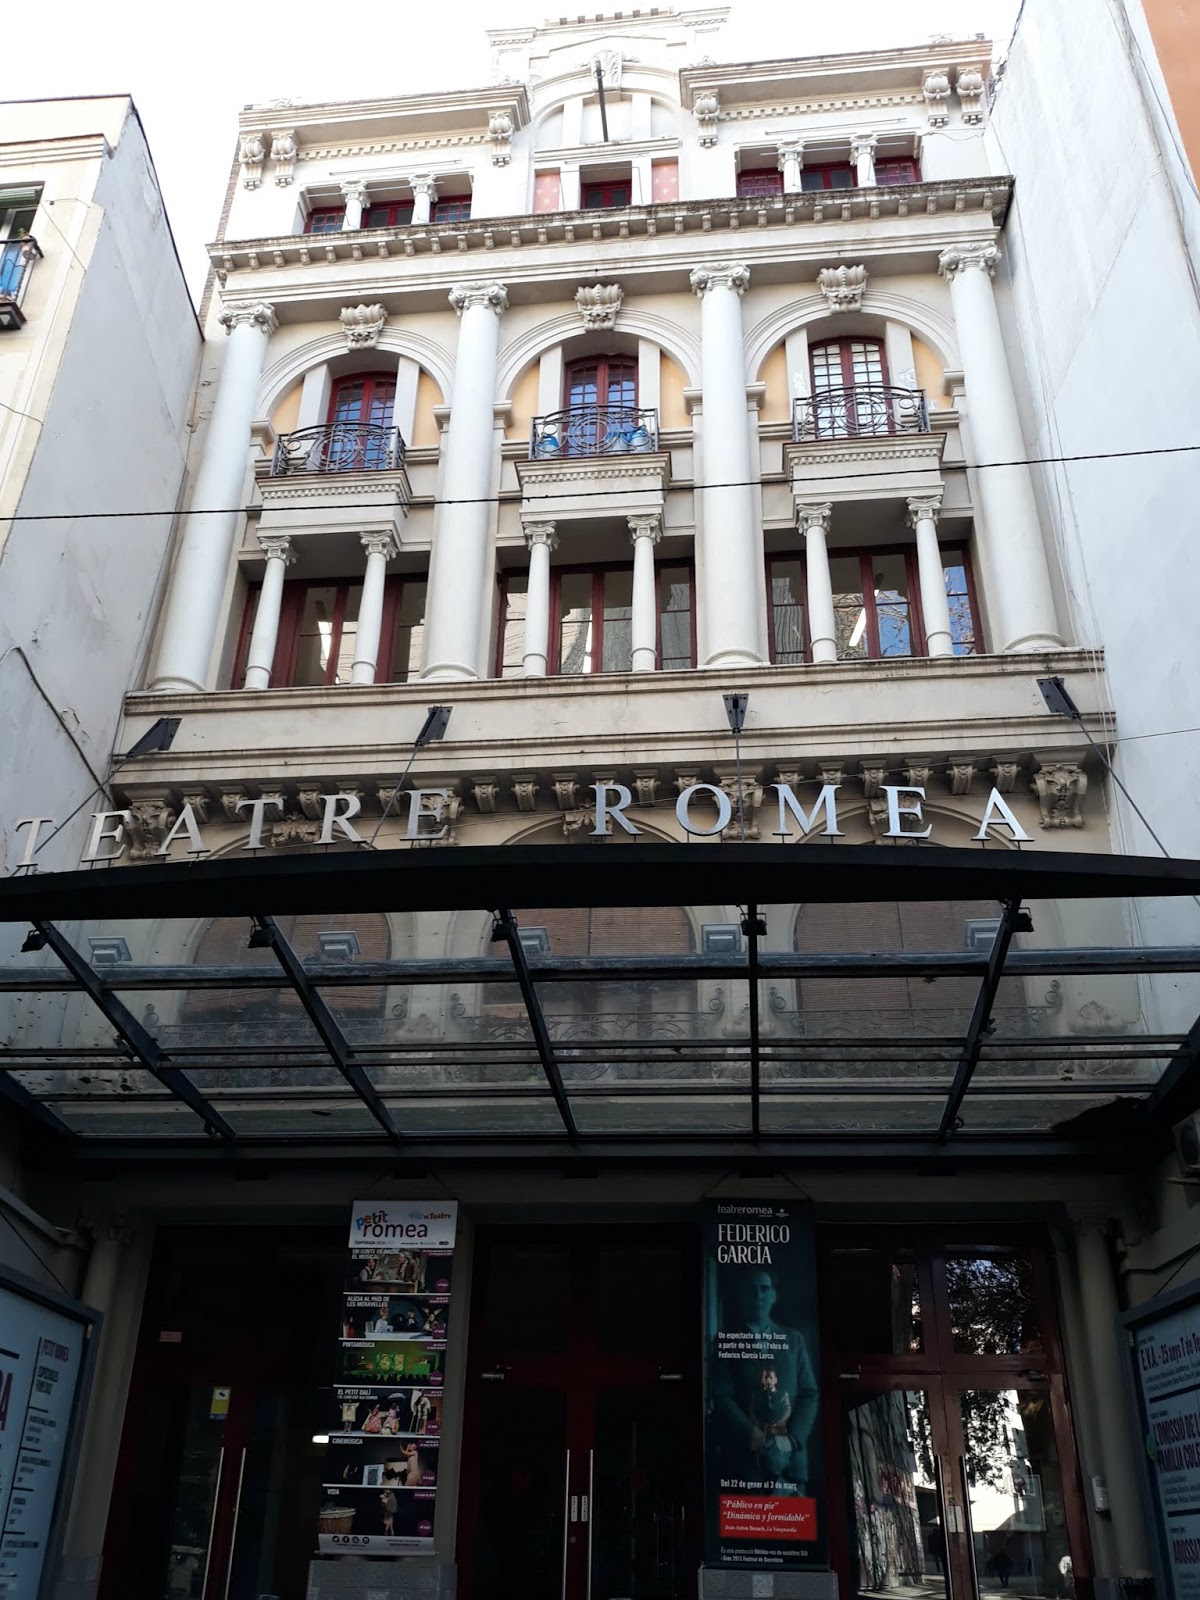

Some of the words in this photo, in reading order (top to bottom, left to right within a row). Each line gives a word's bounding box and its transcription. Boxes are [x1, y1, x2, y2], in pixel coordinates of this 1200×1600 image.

[15, 786, 449, 868] TEATRE
[588, 783, 1036, 842] ROMEA
[356, 1210, 388, 1231] petit
[363, 1223, 428, 1238] romea
[718, 1223, 791, 1244] FEDERICO
[717, 1242, 773, 1264] GARCÍA
[726, 1332, 754, 1340] espectacle
[762, 1333, 772, 1341] Pep
[723, 1342, 737, 1350] partir
[718, 1351, 741, 1359] Federico
[720, 1479, 730, 1488] Del
[731, 1479, 738, 1488] 22
[739, 1480, 746, 1488] de
[747, 1481, 763, 1490] gener
[763, 1480, 769, 1488] al
[775, 1481, 782, 1489] de
[783, 1483, 797, 1491] març
[327, 1488, 340, 1496] VIDA
[761, 1513, 767, 1522] y
